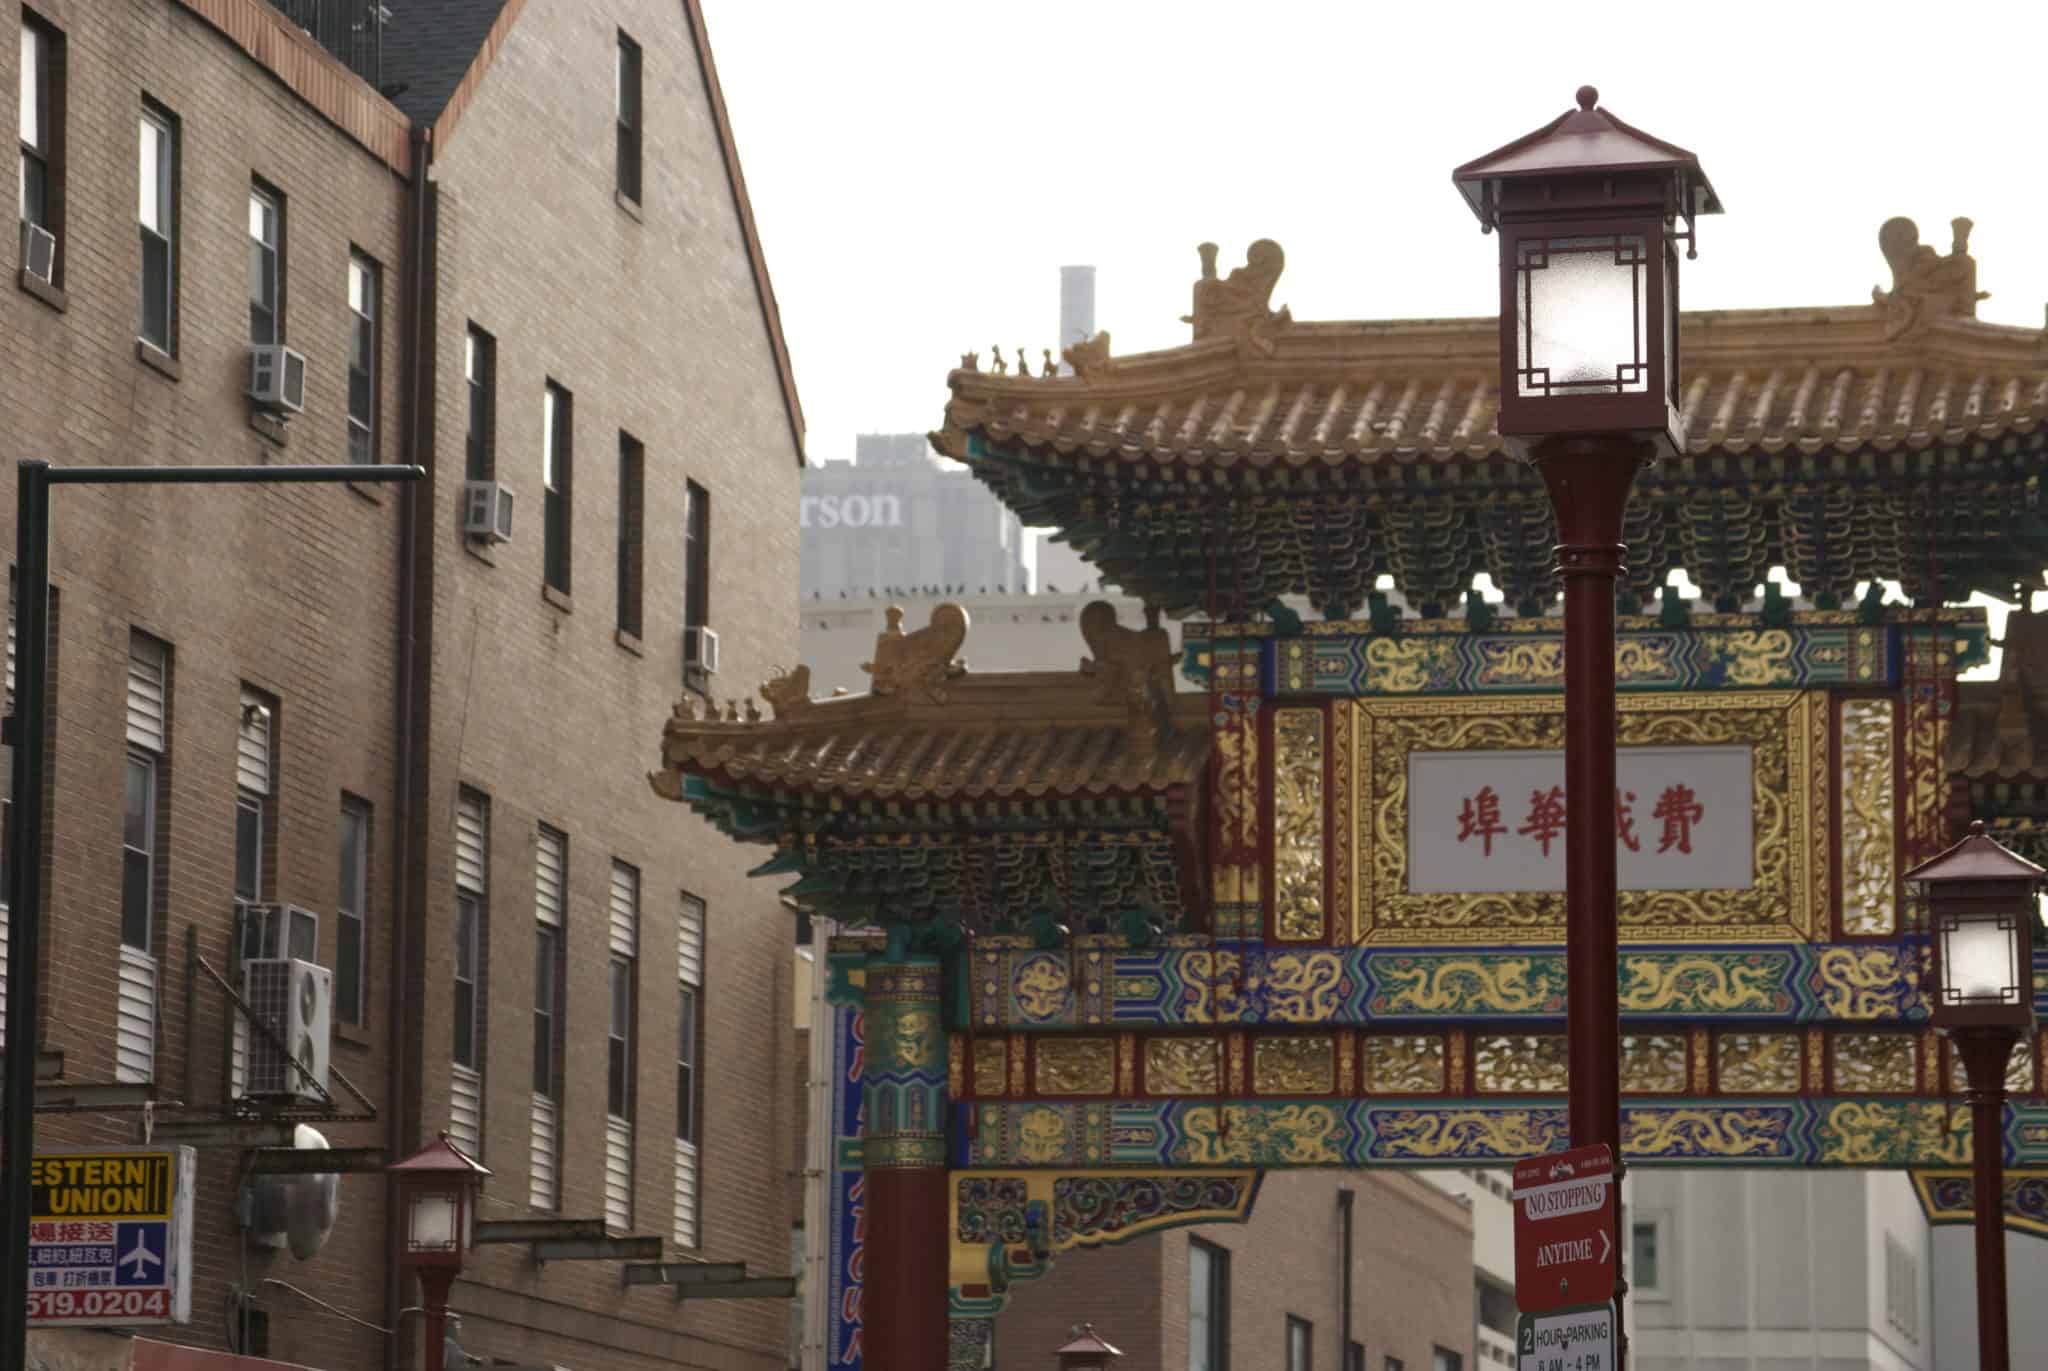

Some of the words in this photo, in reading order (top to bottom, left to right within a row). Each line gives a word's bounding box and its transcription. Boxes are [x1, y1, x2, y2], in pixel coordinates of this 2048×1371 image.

[49, 1187, 145, 1213] UNION
[1529, 1194, 1546, 1215] NO
[1547, 1183, 1602, 1212] STOPPING
[1536, 1238, 1593, 1268] ANYTIME
[1523, 1328, 1532, 1351] 2
[1536, 1328, 1563, 1347] HOUR
[1566, 1321, 1608, 1344] PARKING
[1548, 1357, 1563, 1371] AM
[1575, 1354, 1583, 1371] 4
[1585, 1353, 1601, 1371] PM
